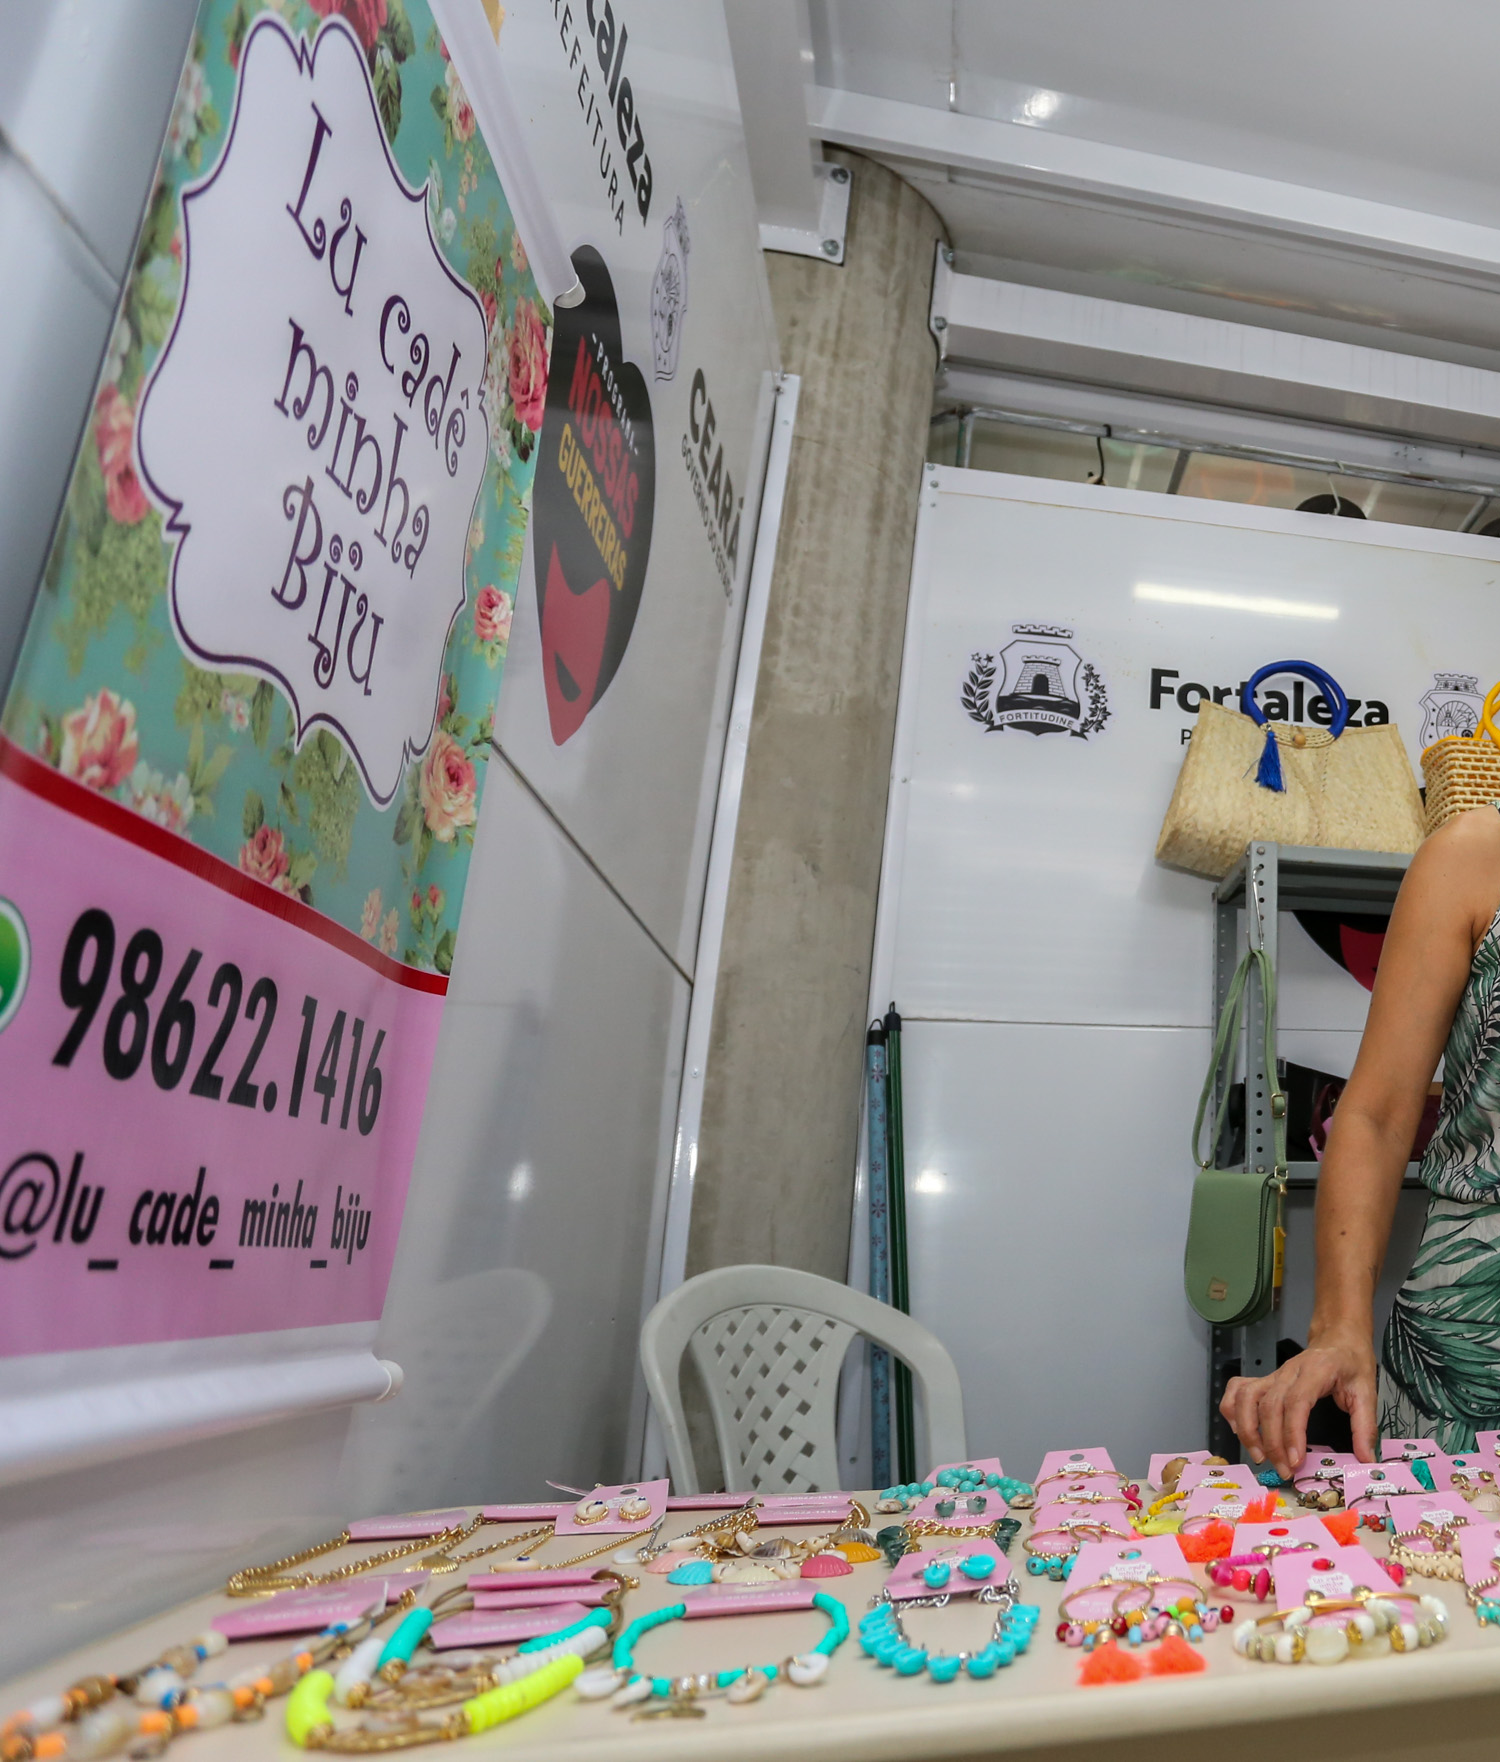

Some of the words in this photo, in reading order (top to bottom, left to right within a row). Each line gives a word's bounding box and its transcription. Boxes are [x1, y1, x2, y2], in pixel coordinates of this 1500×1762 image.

[286, 101, 368, 316] Lu
[274, 317, 430, 581] minha
[558, 422, 628, 591] GUERREIRAS
[568, 335, 639, 539] NOSSAS
[690, 367, 744, 580] CEARÁ
[271, 475, 385, 697] Biju
[998, 710, 1075, 730] FORTITUDINE
[52, 908, 386, 1136] 98622.1416
[0, 1152, 371, 1271] @lu_cade_minha_biju
